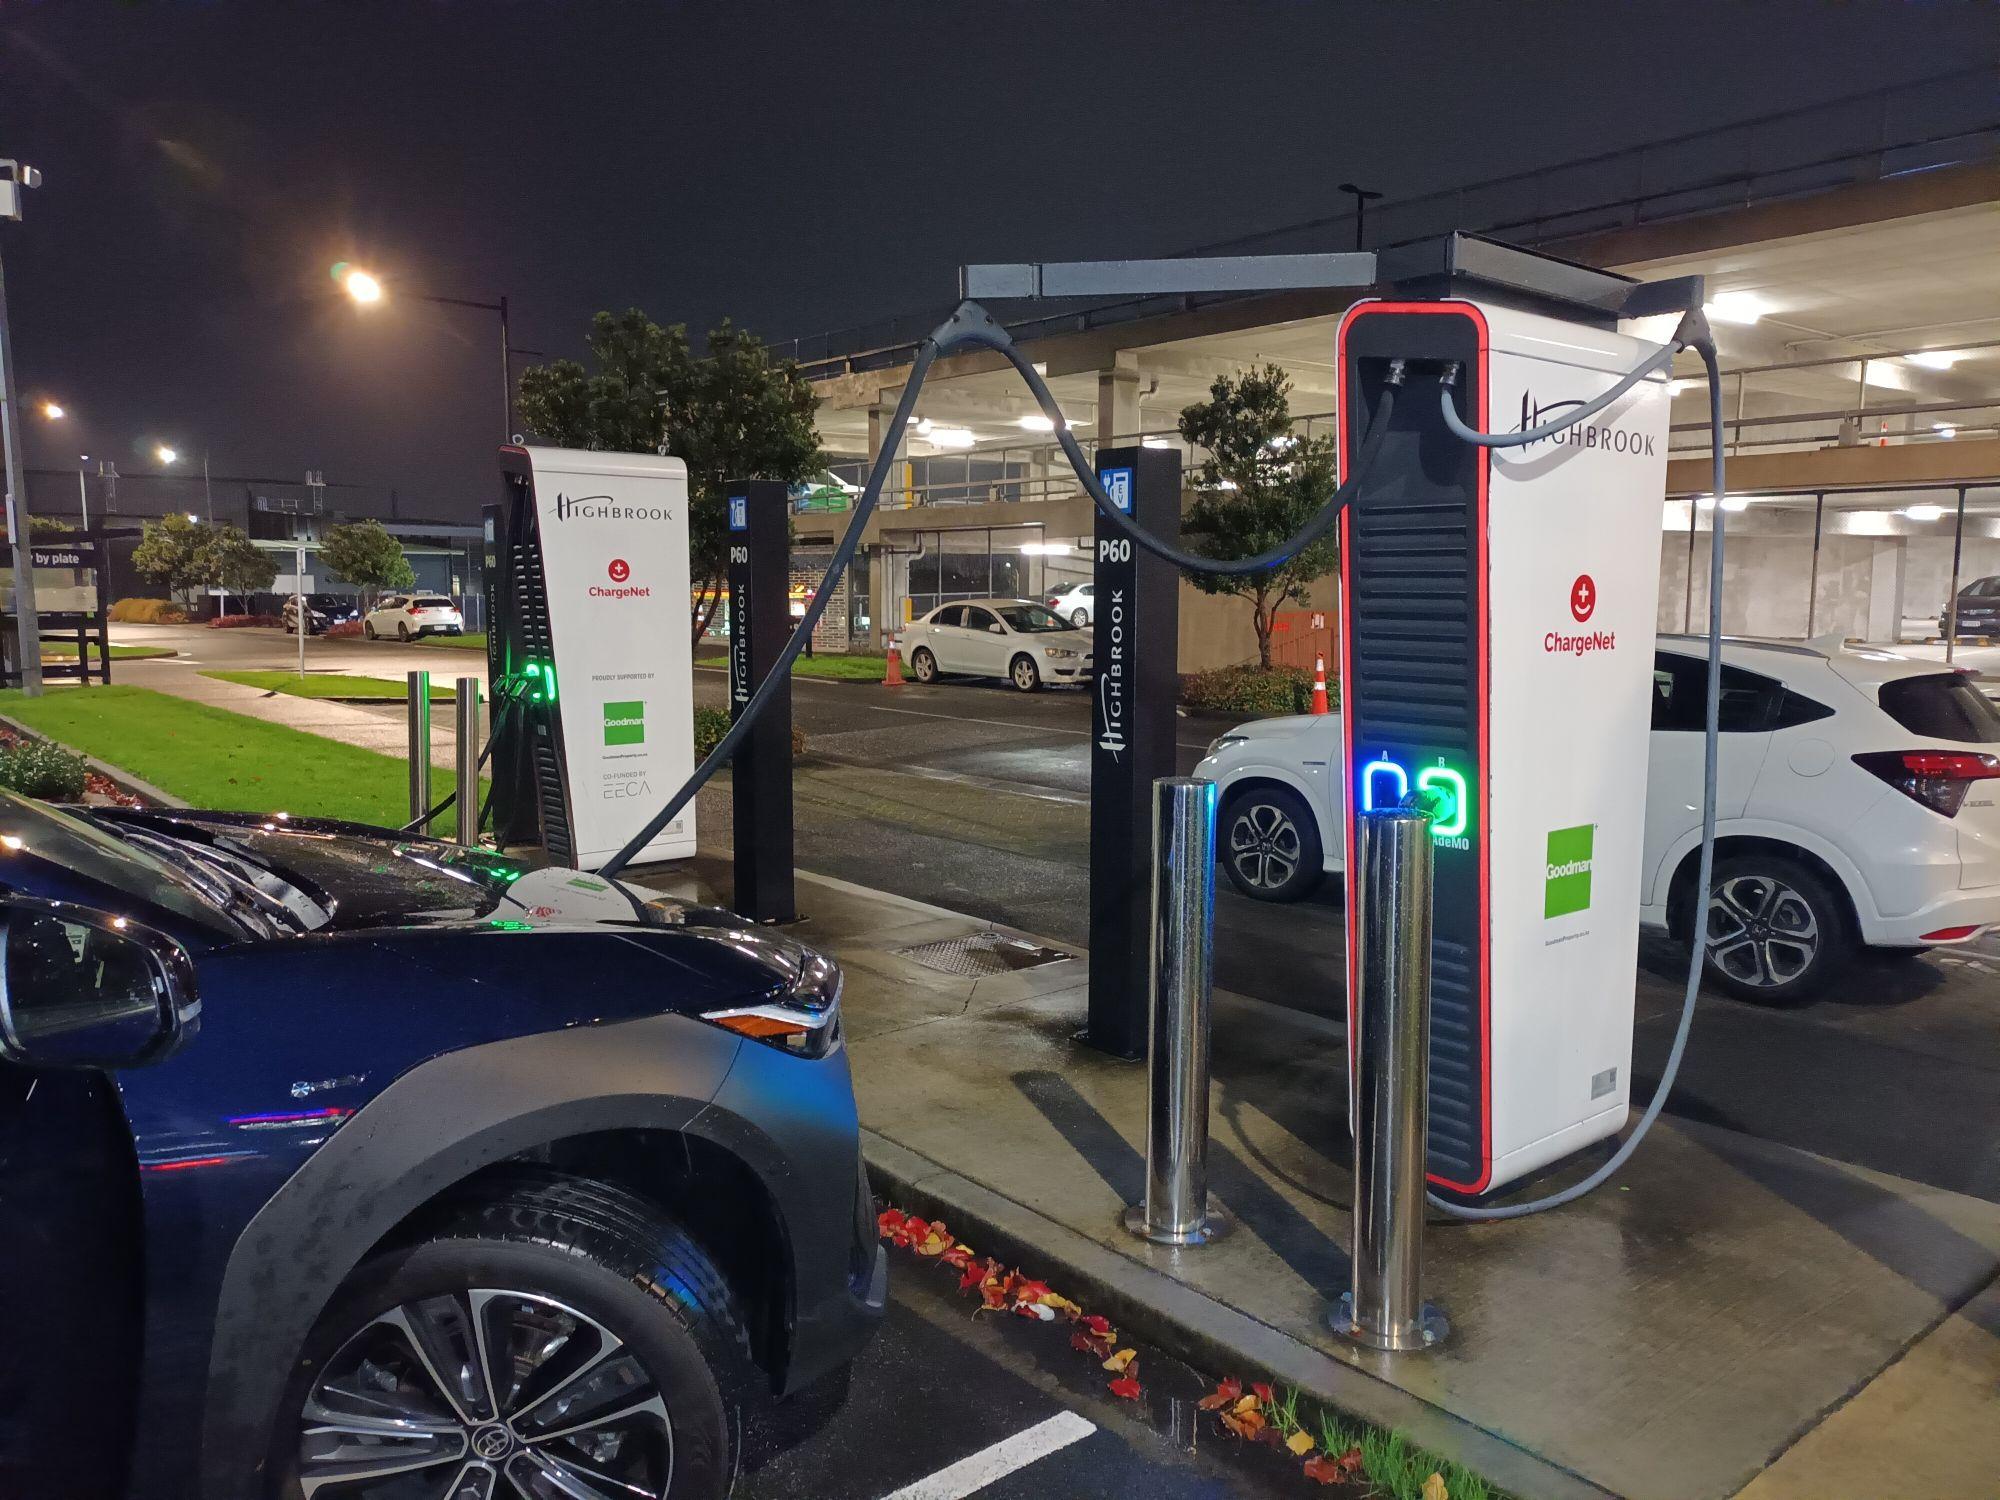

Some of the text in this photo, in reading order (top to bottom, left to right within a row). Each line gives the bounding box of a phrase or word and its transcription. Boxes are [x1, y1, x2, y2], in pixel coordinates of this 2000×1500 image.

[548, 492, 673, 522] HIGHBROOK
[730, 546, 748, 564] P60
[1099, 539, 1131, 563] P60
[36, 552, 80, 565] by plate
[485, 555, 496, 569] P60
[588, 586, 650, 600] ChargeNet
[734, 584, 750, 711] HIGHBROOK
[1544, 631, 1616, 657] ChargeNet
[592, 674, 616, 682] PROUDLY
[617, 673, 647, 681] SUPPORTED
[1099, 589, 1127, 763] HIGHBROOK
[604, 717, 644, 727] Goodman
[1381, 750, 1388, 761] A
[1438, 756, 1446, 768] B
[603, 770, 647, 780] CO-FUNDED BY
[603, 780, 652, 799] EECA
[1433, 836, 1470, 850] AdeMO
[1545, 859, 1592, 880] Goodman
